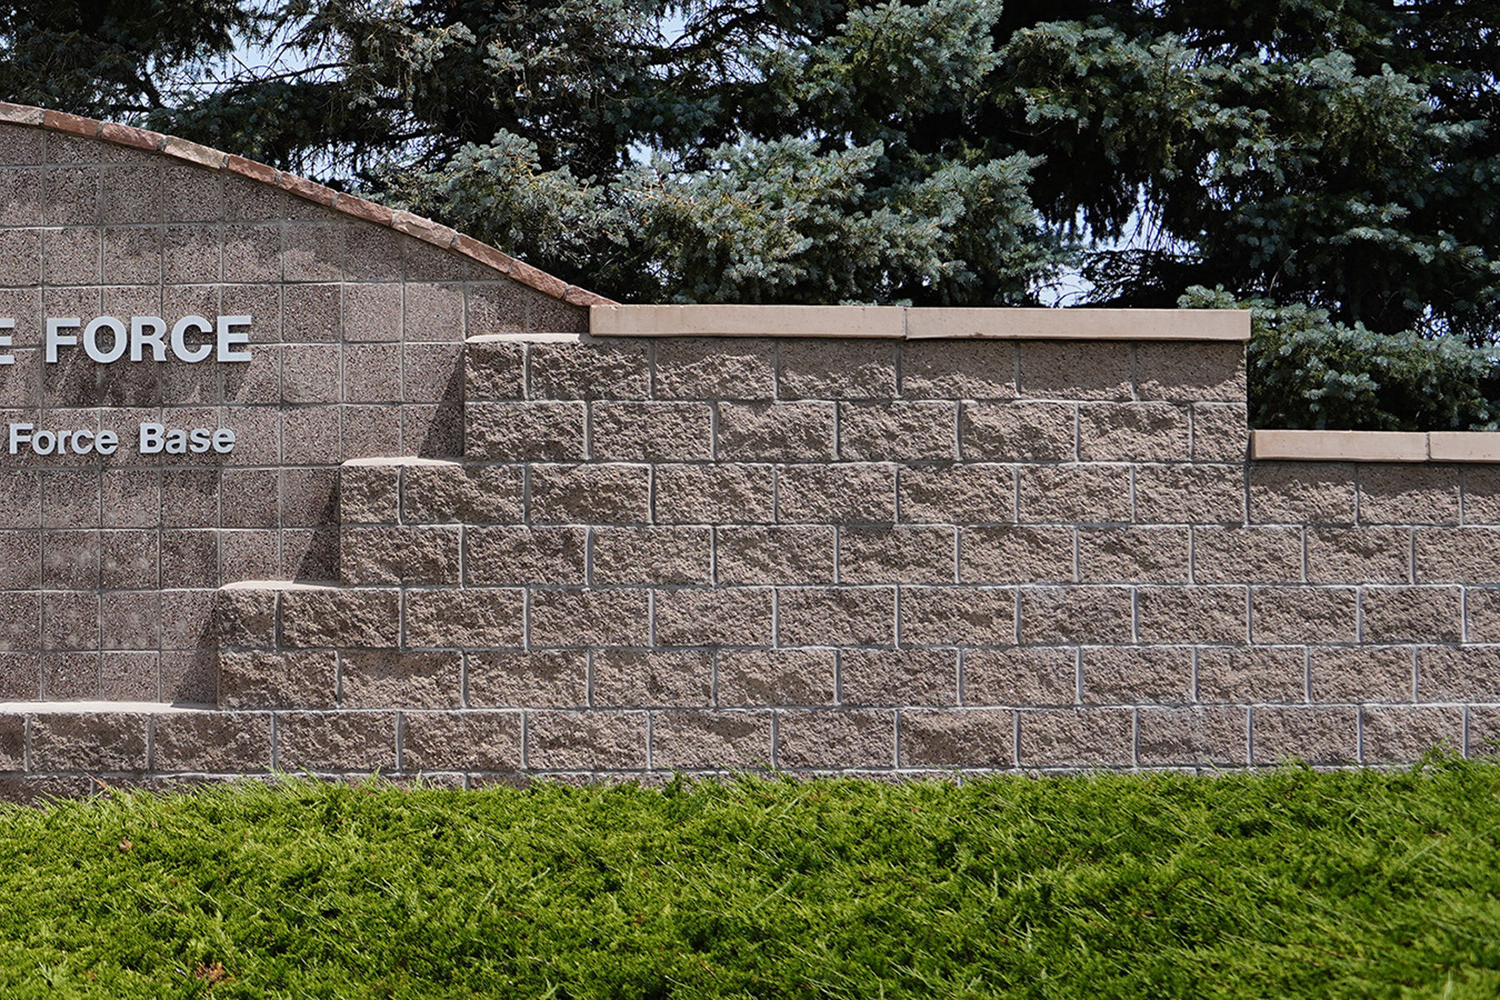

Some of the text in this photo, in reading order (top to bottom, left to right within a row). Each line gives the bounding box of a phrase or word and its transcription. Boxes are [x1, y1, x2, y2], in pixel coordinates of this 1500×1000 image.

[46, 315, 252, 363] FORCE
[9, 422, 119, 455] Force
[139, 422, 236, 454] Base
